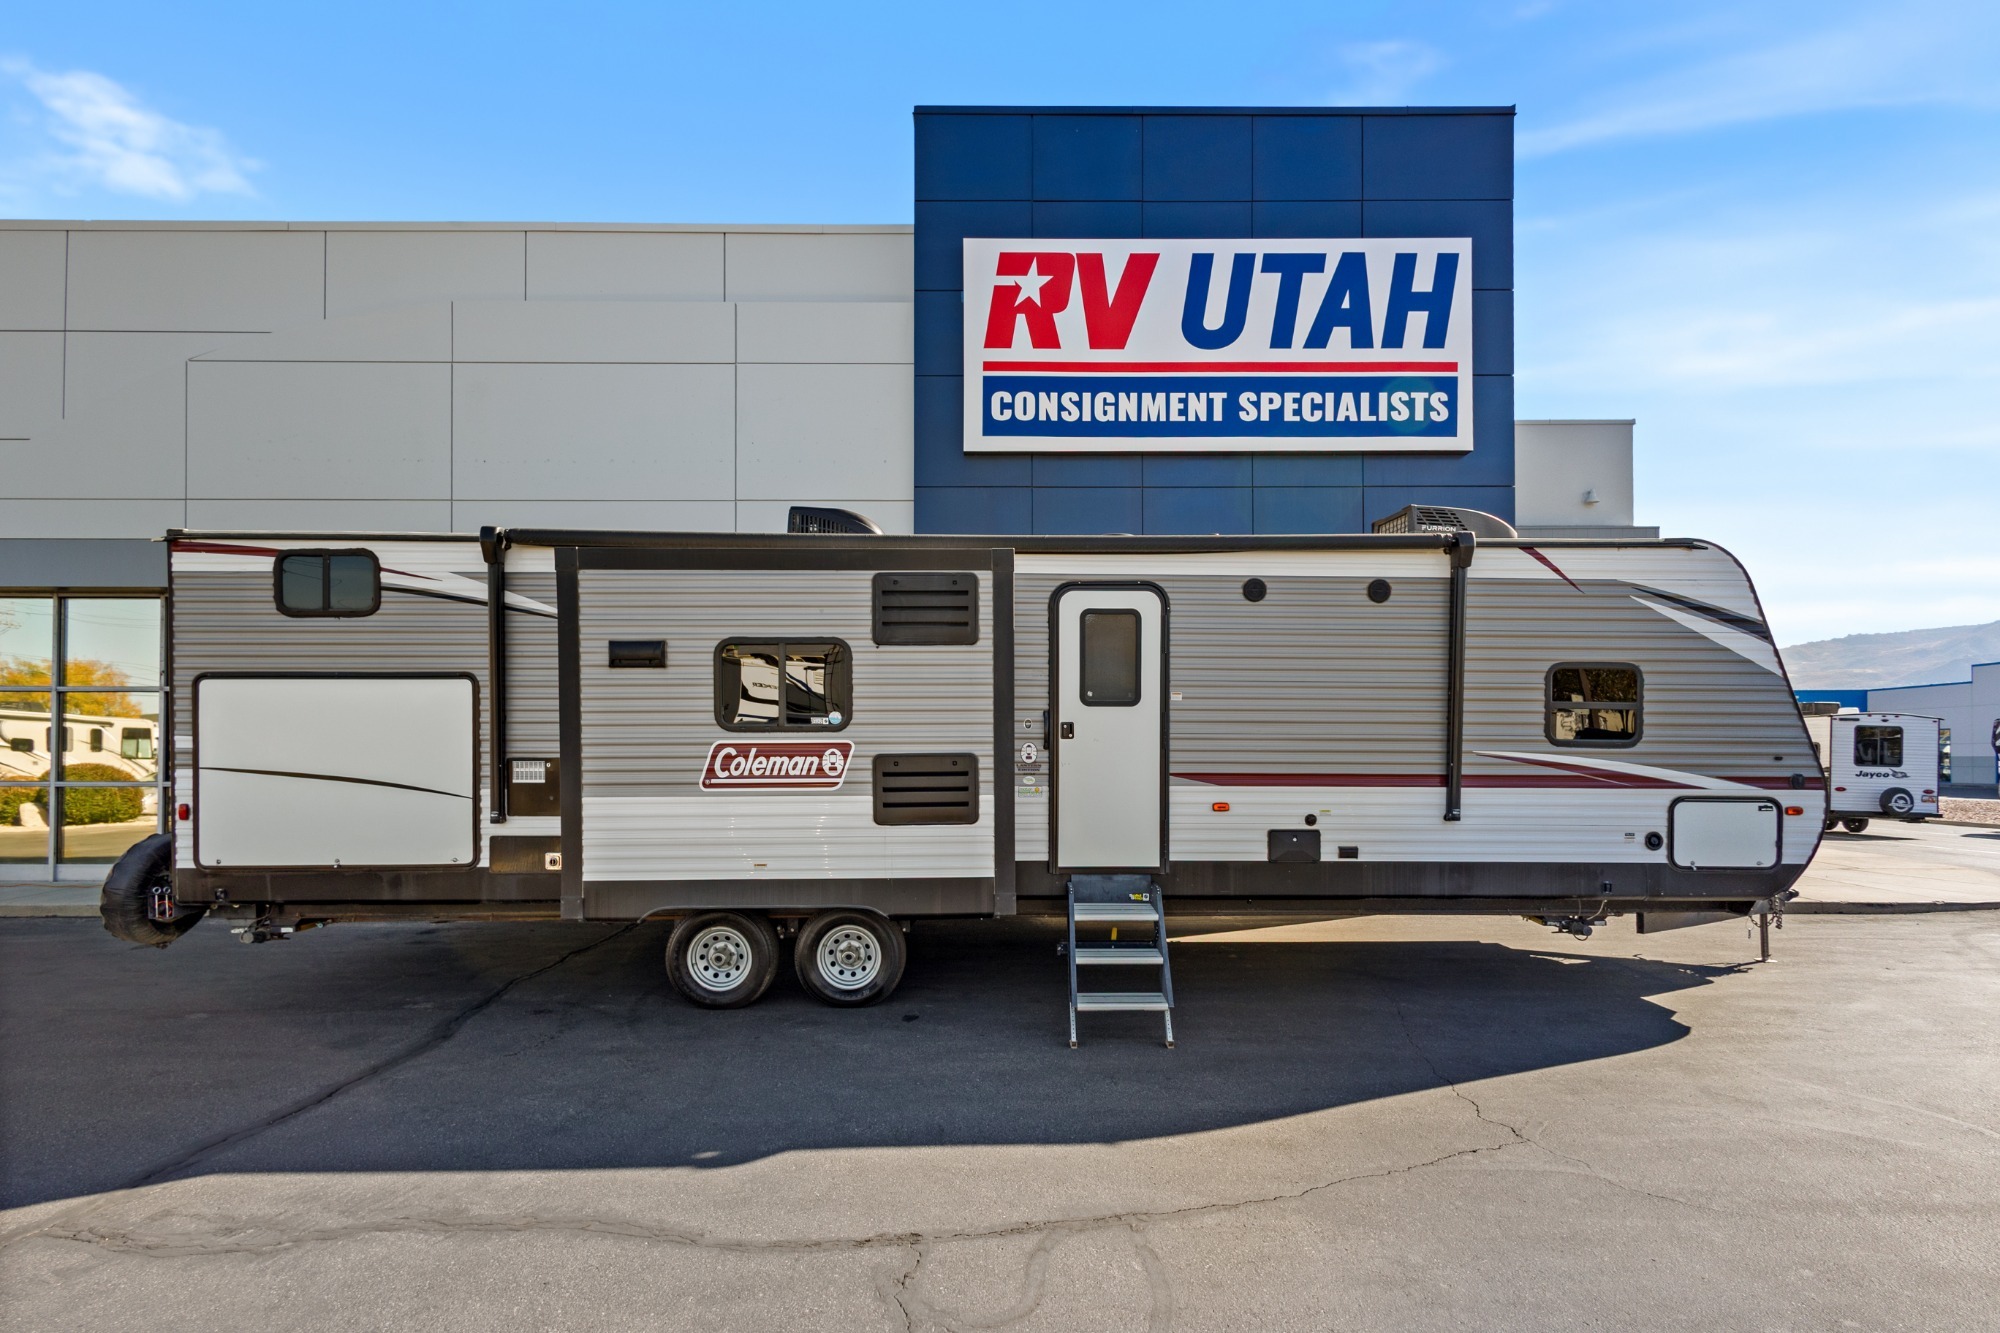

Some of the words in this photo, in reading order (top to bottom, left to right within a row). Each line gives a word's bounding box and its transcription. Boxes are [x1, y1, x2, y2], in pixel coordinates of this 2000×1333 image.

[983, 252, 1161, 350] RV
[1181, 252, 1460, 350] UTAH
[990, 390, 1228, 423] CONSIGNMENT
[1238, 391, 1449, 423] SPECIALISTS
[714, 747, 820, 779] Coleman
[1855, 770, 1890, 779] Jayco
